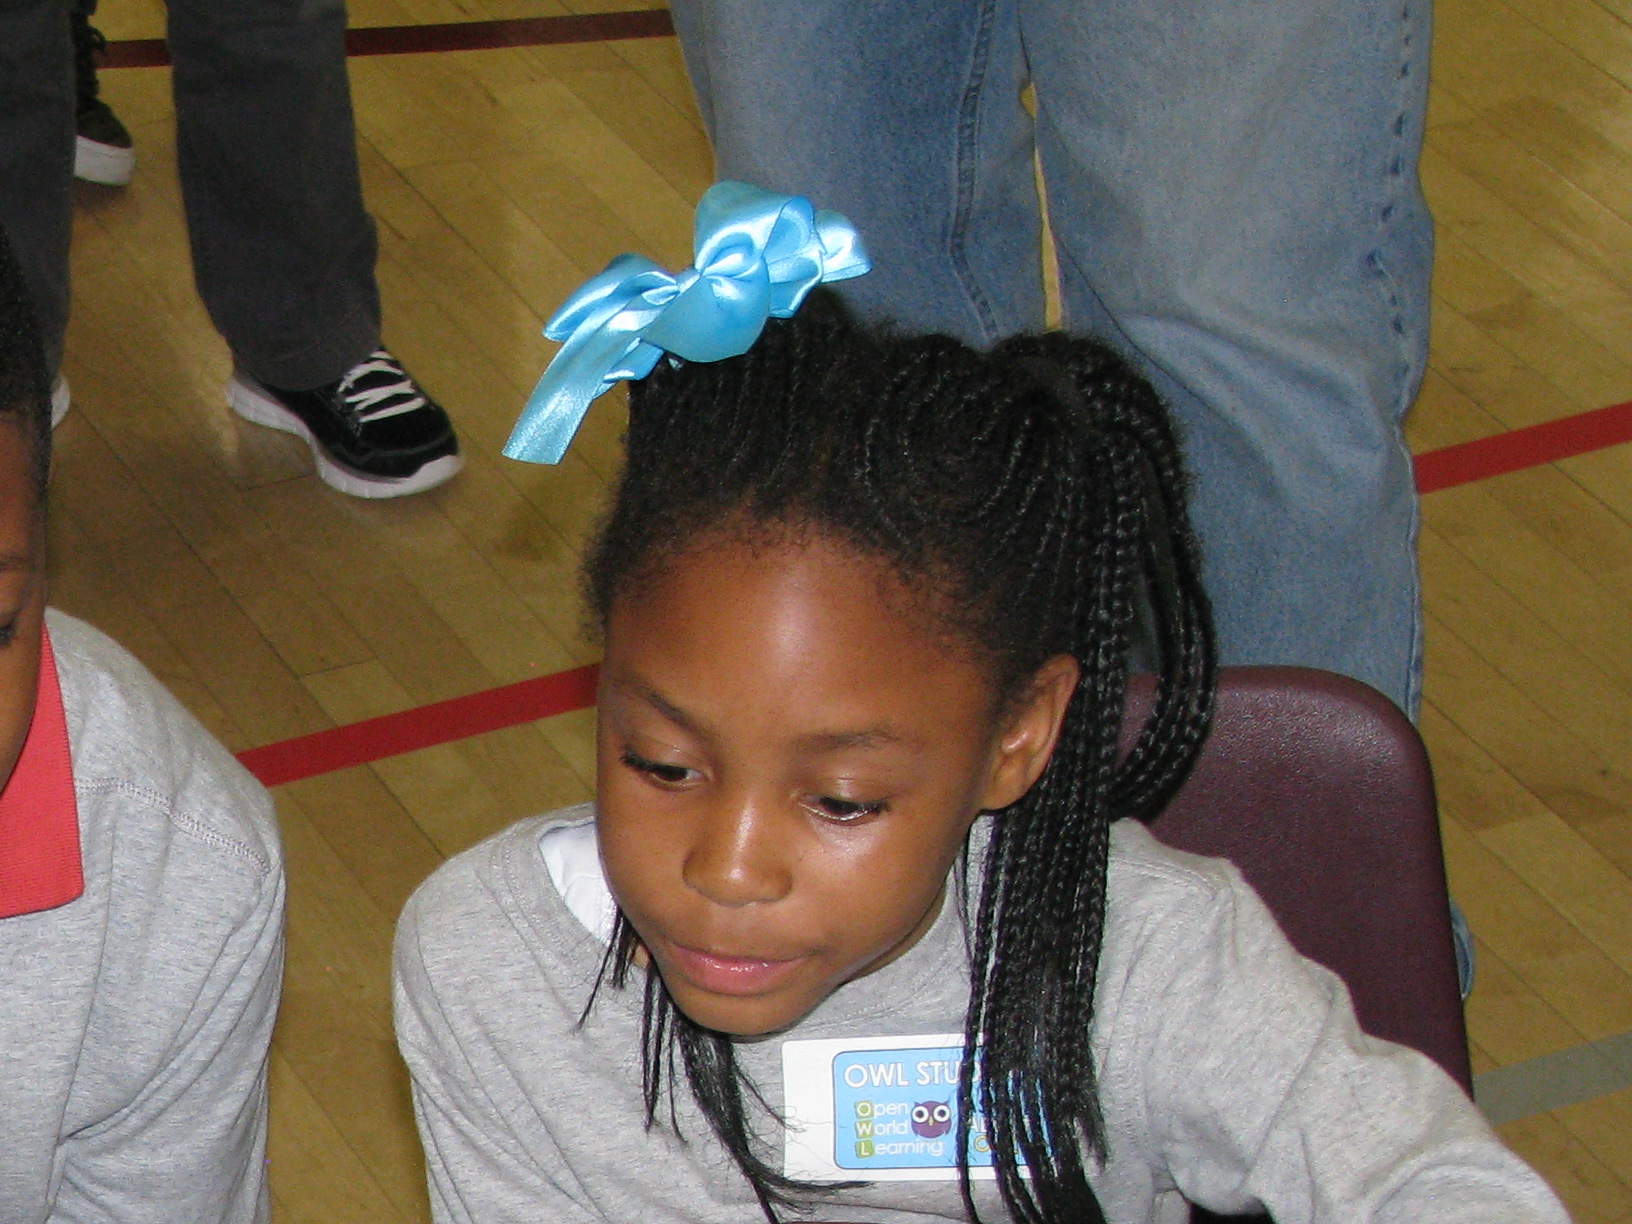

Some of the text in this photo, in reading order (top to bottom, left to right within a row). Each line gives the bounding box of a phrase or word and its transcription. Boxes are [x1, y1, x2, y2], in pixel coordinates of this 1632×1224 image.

[844, 1063, 910, 1089] OWL
[856, 1101, 909, 1118] Open
[856, 1120, 909, 1136] World
[860, 1140, 945, 1157] Learning
